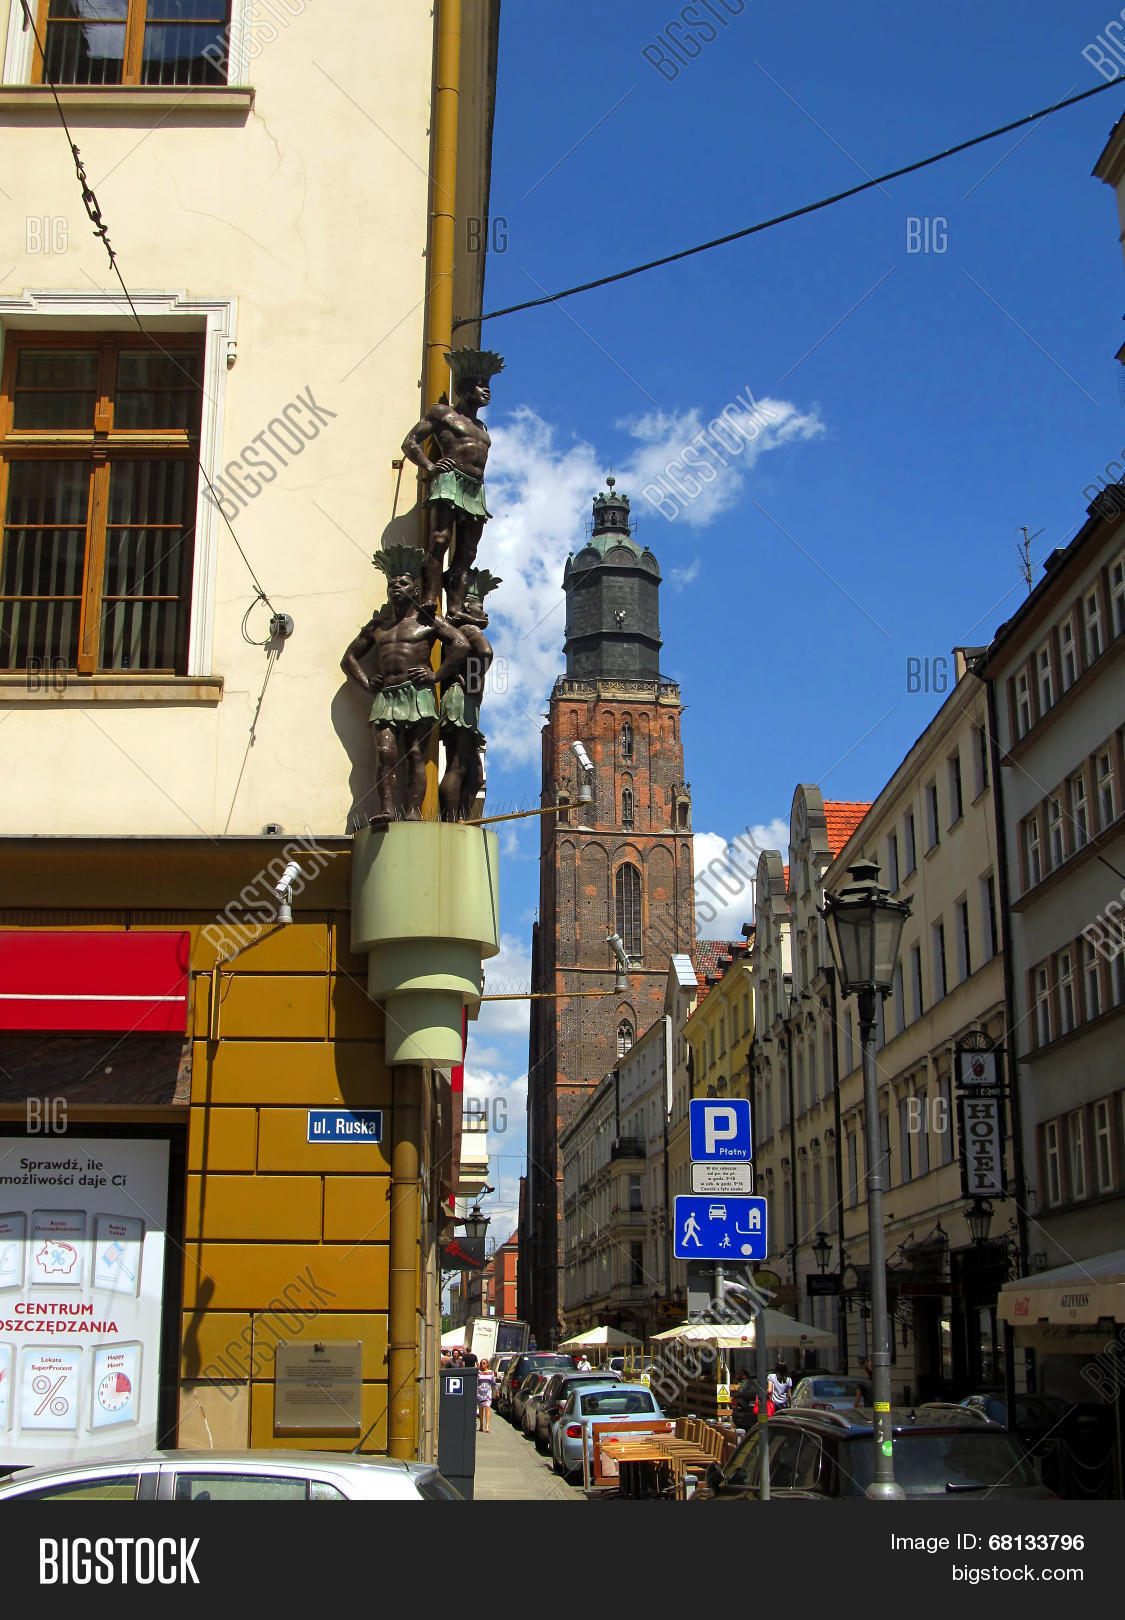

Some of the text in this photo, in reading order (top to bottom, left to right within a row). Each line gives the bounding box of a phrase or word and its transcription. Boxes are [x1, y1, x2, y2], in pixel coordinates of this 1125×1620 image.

[313, 1118, 376, 1134] ul. Ruska
[704, 1107, 737, 1153] P
[719, 1147, 747, 1157] Płatny
[967, 1103, 995, 1189] HOTEL
[20, 1158, 104, 1172] Sprawdź, ile
[0, 1173, 127, 1188] możliwości daje Ci
[14, 1302, 94, 1316] CENTRUM
[31, 1364, 73, 1372] SuperProcent
[449, 1378, 461, 1394] P
